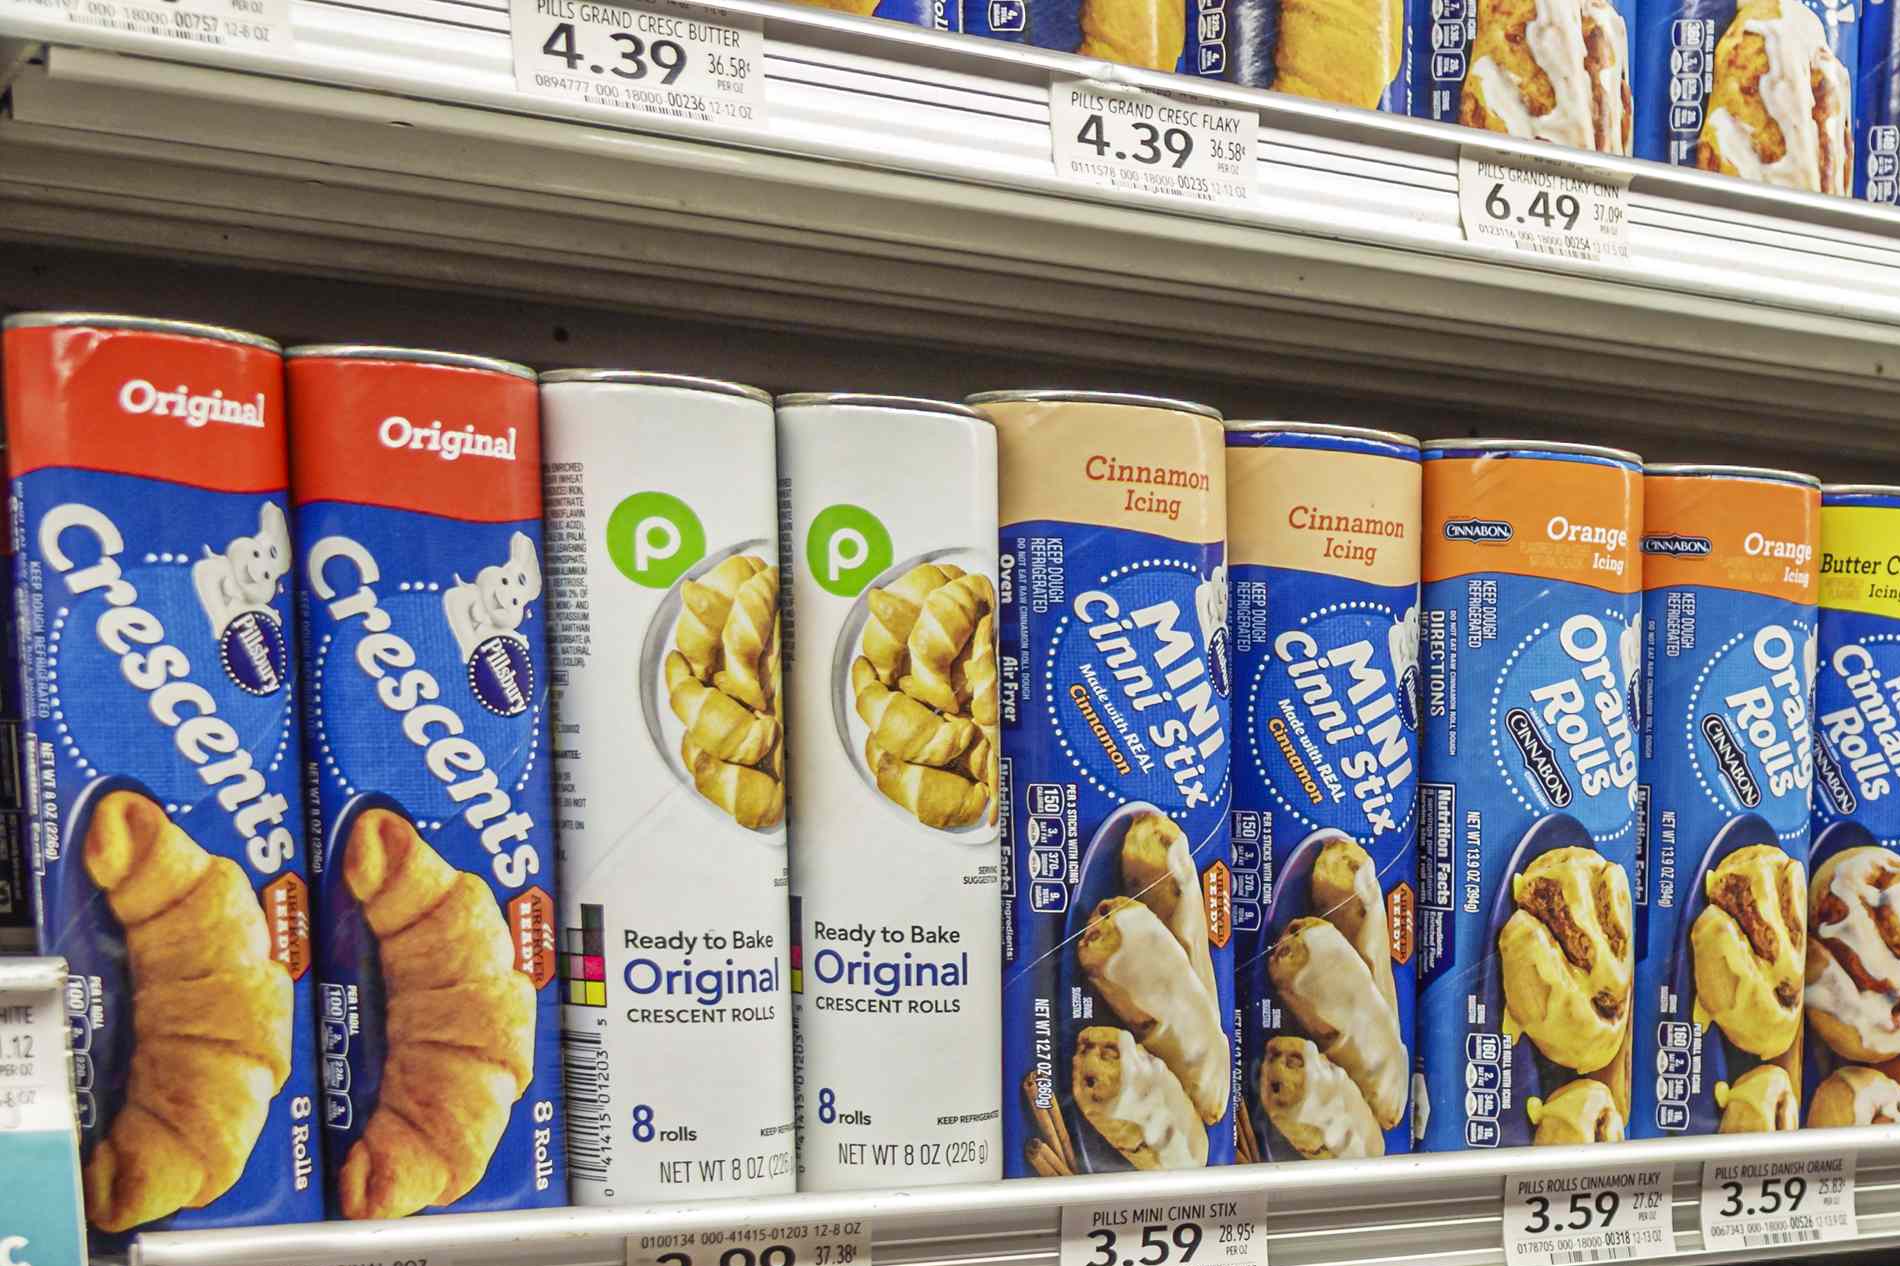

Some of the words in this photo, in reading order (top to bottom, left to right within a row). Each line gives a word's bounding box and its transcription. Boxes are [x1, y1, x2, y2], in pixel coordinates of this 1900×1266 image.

[580, 4, 632, 29] GRAND
[638, 15, 683, 38] CRESC
[689, 23, 740, 48] BUTTER
[543, 22, 688, 85] 4.39
[1077, 114, 1194, 168] 4.39
[1478, 163, 1505, 181] PILLS
[1559, 178, 1591, 196] FLAKY
[1485, 183, 1580, 231] 6.49
[120, 379, 265, 429] Original
[379, 416, 516, 461] Original
[1085, 455, 1209, 491] Cinnamon
[1124, 489, 1181, 520] Icing
[1288, 506, 1404, 538] Cinnamon
[1324, 537, 1377, 566] Icing
[1546, 517, 1627, 549] Orange
[1744, 532, 1812, 563] Orange
[1592, 553, 1625, 576] Icing
[1820, 554, 1882, 574] Butter
[38, 503, 294, 874] Crescents
[1073, 590, 1172, 711] Cinni
[1149, 721, 1208, 809] Stix
[1131, 601, 1225, 759] MINI
[307, 535, 540, 888] Crescents
[1274, 631, 1364, 745] Cinni
[1342, 751, 1396, 835] Stix
[1327, 640, 1412, 788] MINI
[1530, 678, 1610, 797] Rolls
[1725, 686, 1798, 797] Rolls
[1820, 706, 1889, 801] Rolls
[624, 931, 697, 955] Ready
[703, 931, 726, 950] to
[732, 931, 774, 950] Bake
[814, 922, 875, 945] Ready
[880, 925, 904, 944] to
[909, 925, 961, 944] Bake
[623, 956, 780, 1006] Original
[814, 948, 969, 996] Original
[627, 1006, 727, 1024] CRESCENT
[731, 1006, 775, 1023] ROLLS
[815, 997, 896, 1013] CRESCENT
[901, 997, 961, 1013] ROLLS
[631, 1105, 655, 1142] 8
[660, 1126, 698, 1143] rolls
[818, 1088, 836, 1125] 8
[839, 1109, 872, 1127] rolls
[1093, 1209, 1128, 1226] PILLS
[1132, 1207, 1163, 1223] MINI
[1168, 1205, 1205, 1220] CINNI
[1210, 1202, 1237, 1217] STIX
[1524, 1190, 1620, 1234] 3.59
[1720, 1176, 1807, 1218] 3.59
[641, 1233, 695, 1249] 0100134
